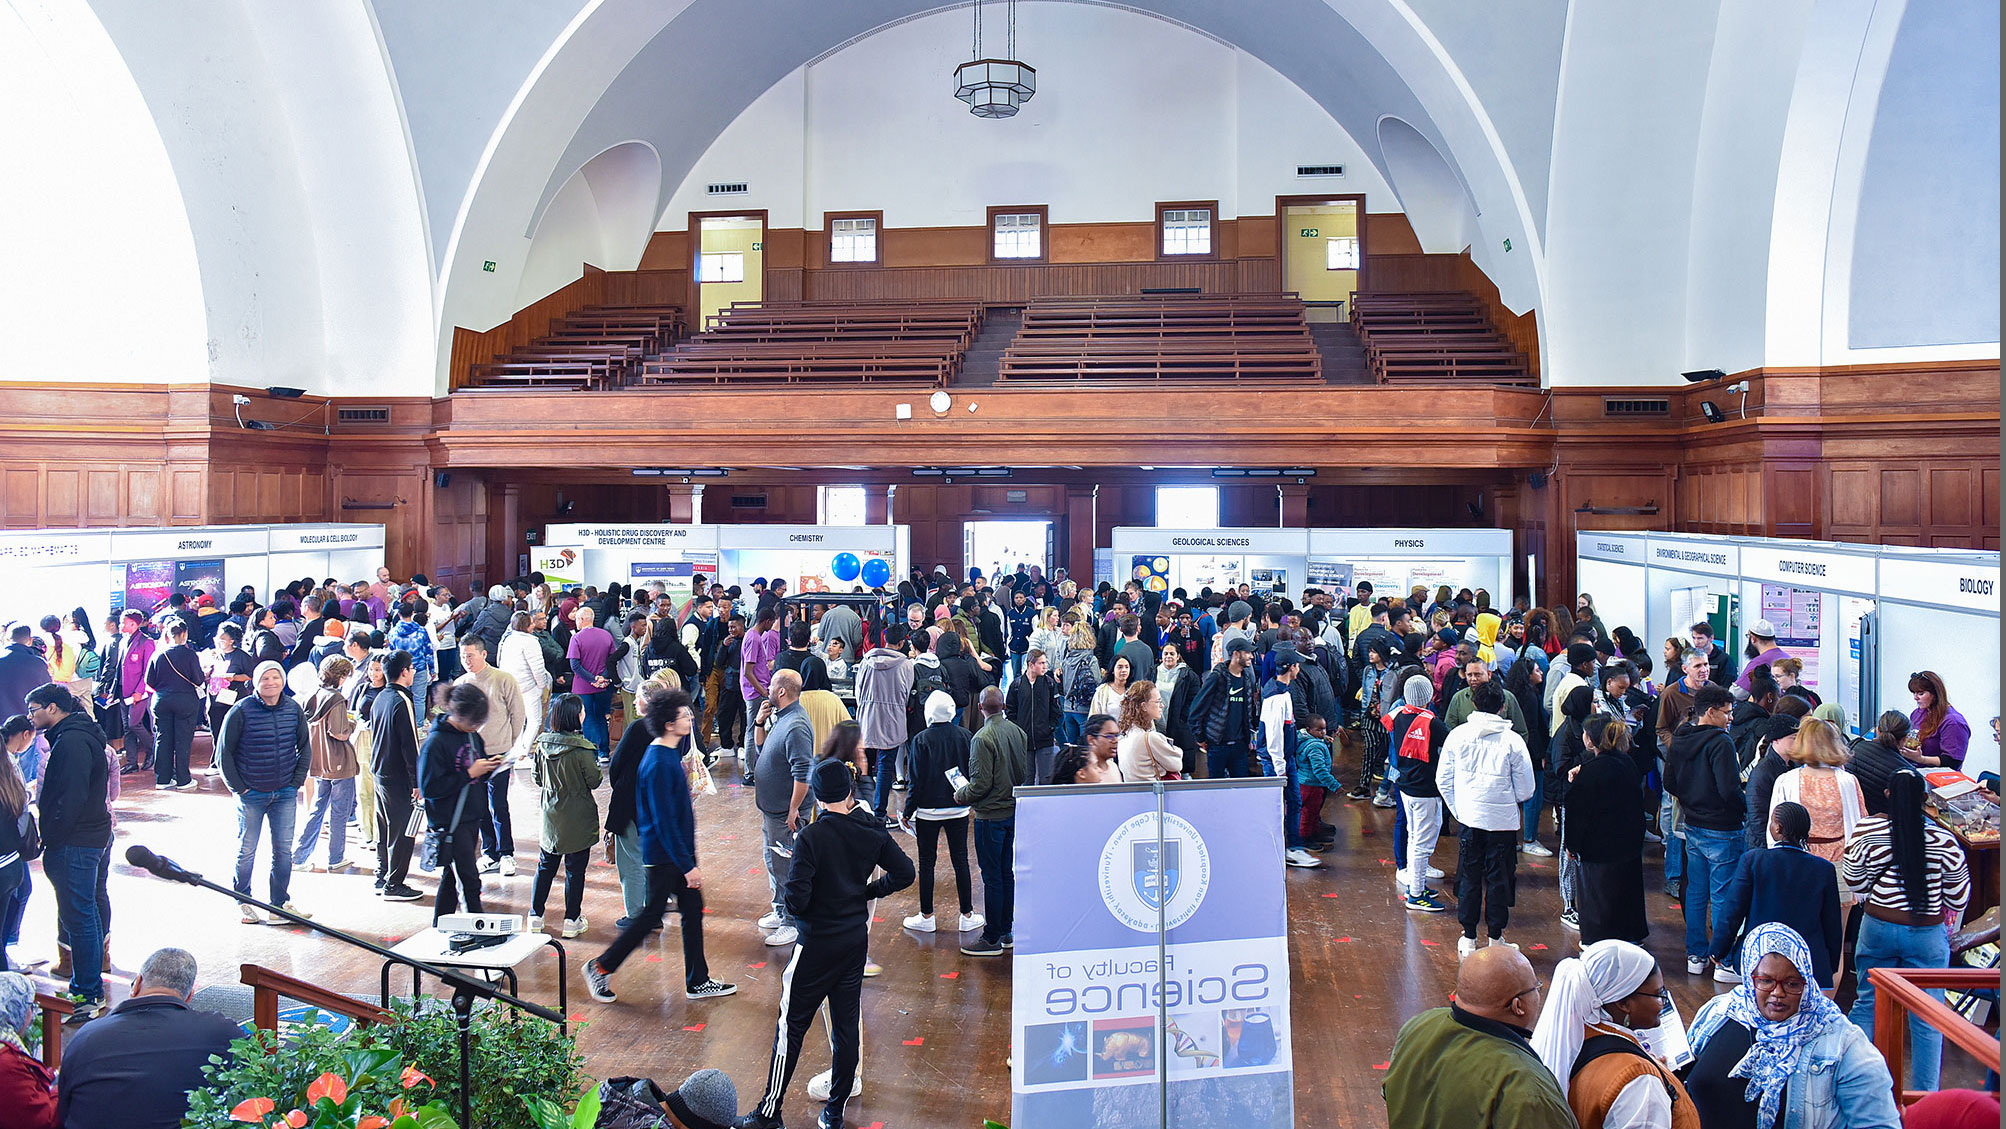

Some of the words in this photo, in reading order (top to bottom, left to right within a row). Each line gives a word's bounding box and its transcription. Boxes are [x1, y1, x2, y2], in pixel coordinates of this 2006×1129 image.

[594, 529, 621, 537] HOLISTIC
[621, 529, 639, 537] DRUG
[639, 529, 673, 537] DISCOVERY
[673, 529, 687, 537] AND
[789, 534, 824, 542] CHEMISTRY
[300, 535, 326, 544] MOLECULAR
[329, 535, 340, 543] CELL
[340, 534, 358, 542] BIOLOGY
[642, 538, 666, 546] CENTRE
[1172, 537, 1216, 546] GEOLOGICAL
[1216, 538, 1250, 546] SCIENCES
[1394, 539, 1424, 548] PHYSICS
[178, 540, 213, 550] ASTRONOMY
[540, 559, 565, 569] H3D
[1710, 553, 1727, 565] SCIENCE
[1779, 560, 1805, 574] COMPUTER
[1805, 563, 1827, 577] SCIENCE
[129, 580, 173, 590] ASTRONOMY
[178, 578, 221, 588] ASTRONOMY
[1960, 578, 1994, 596] BIOLOGY
